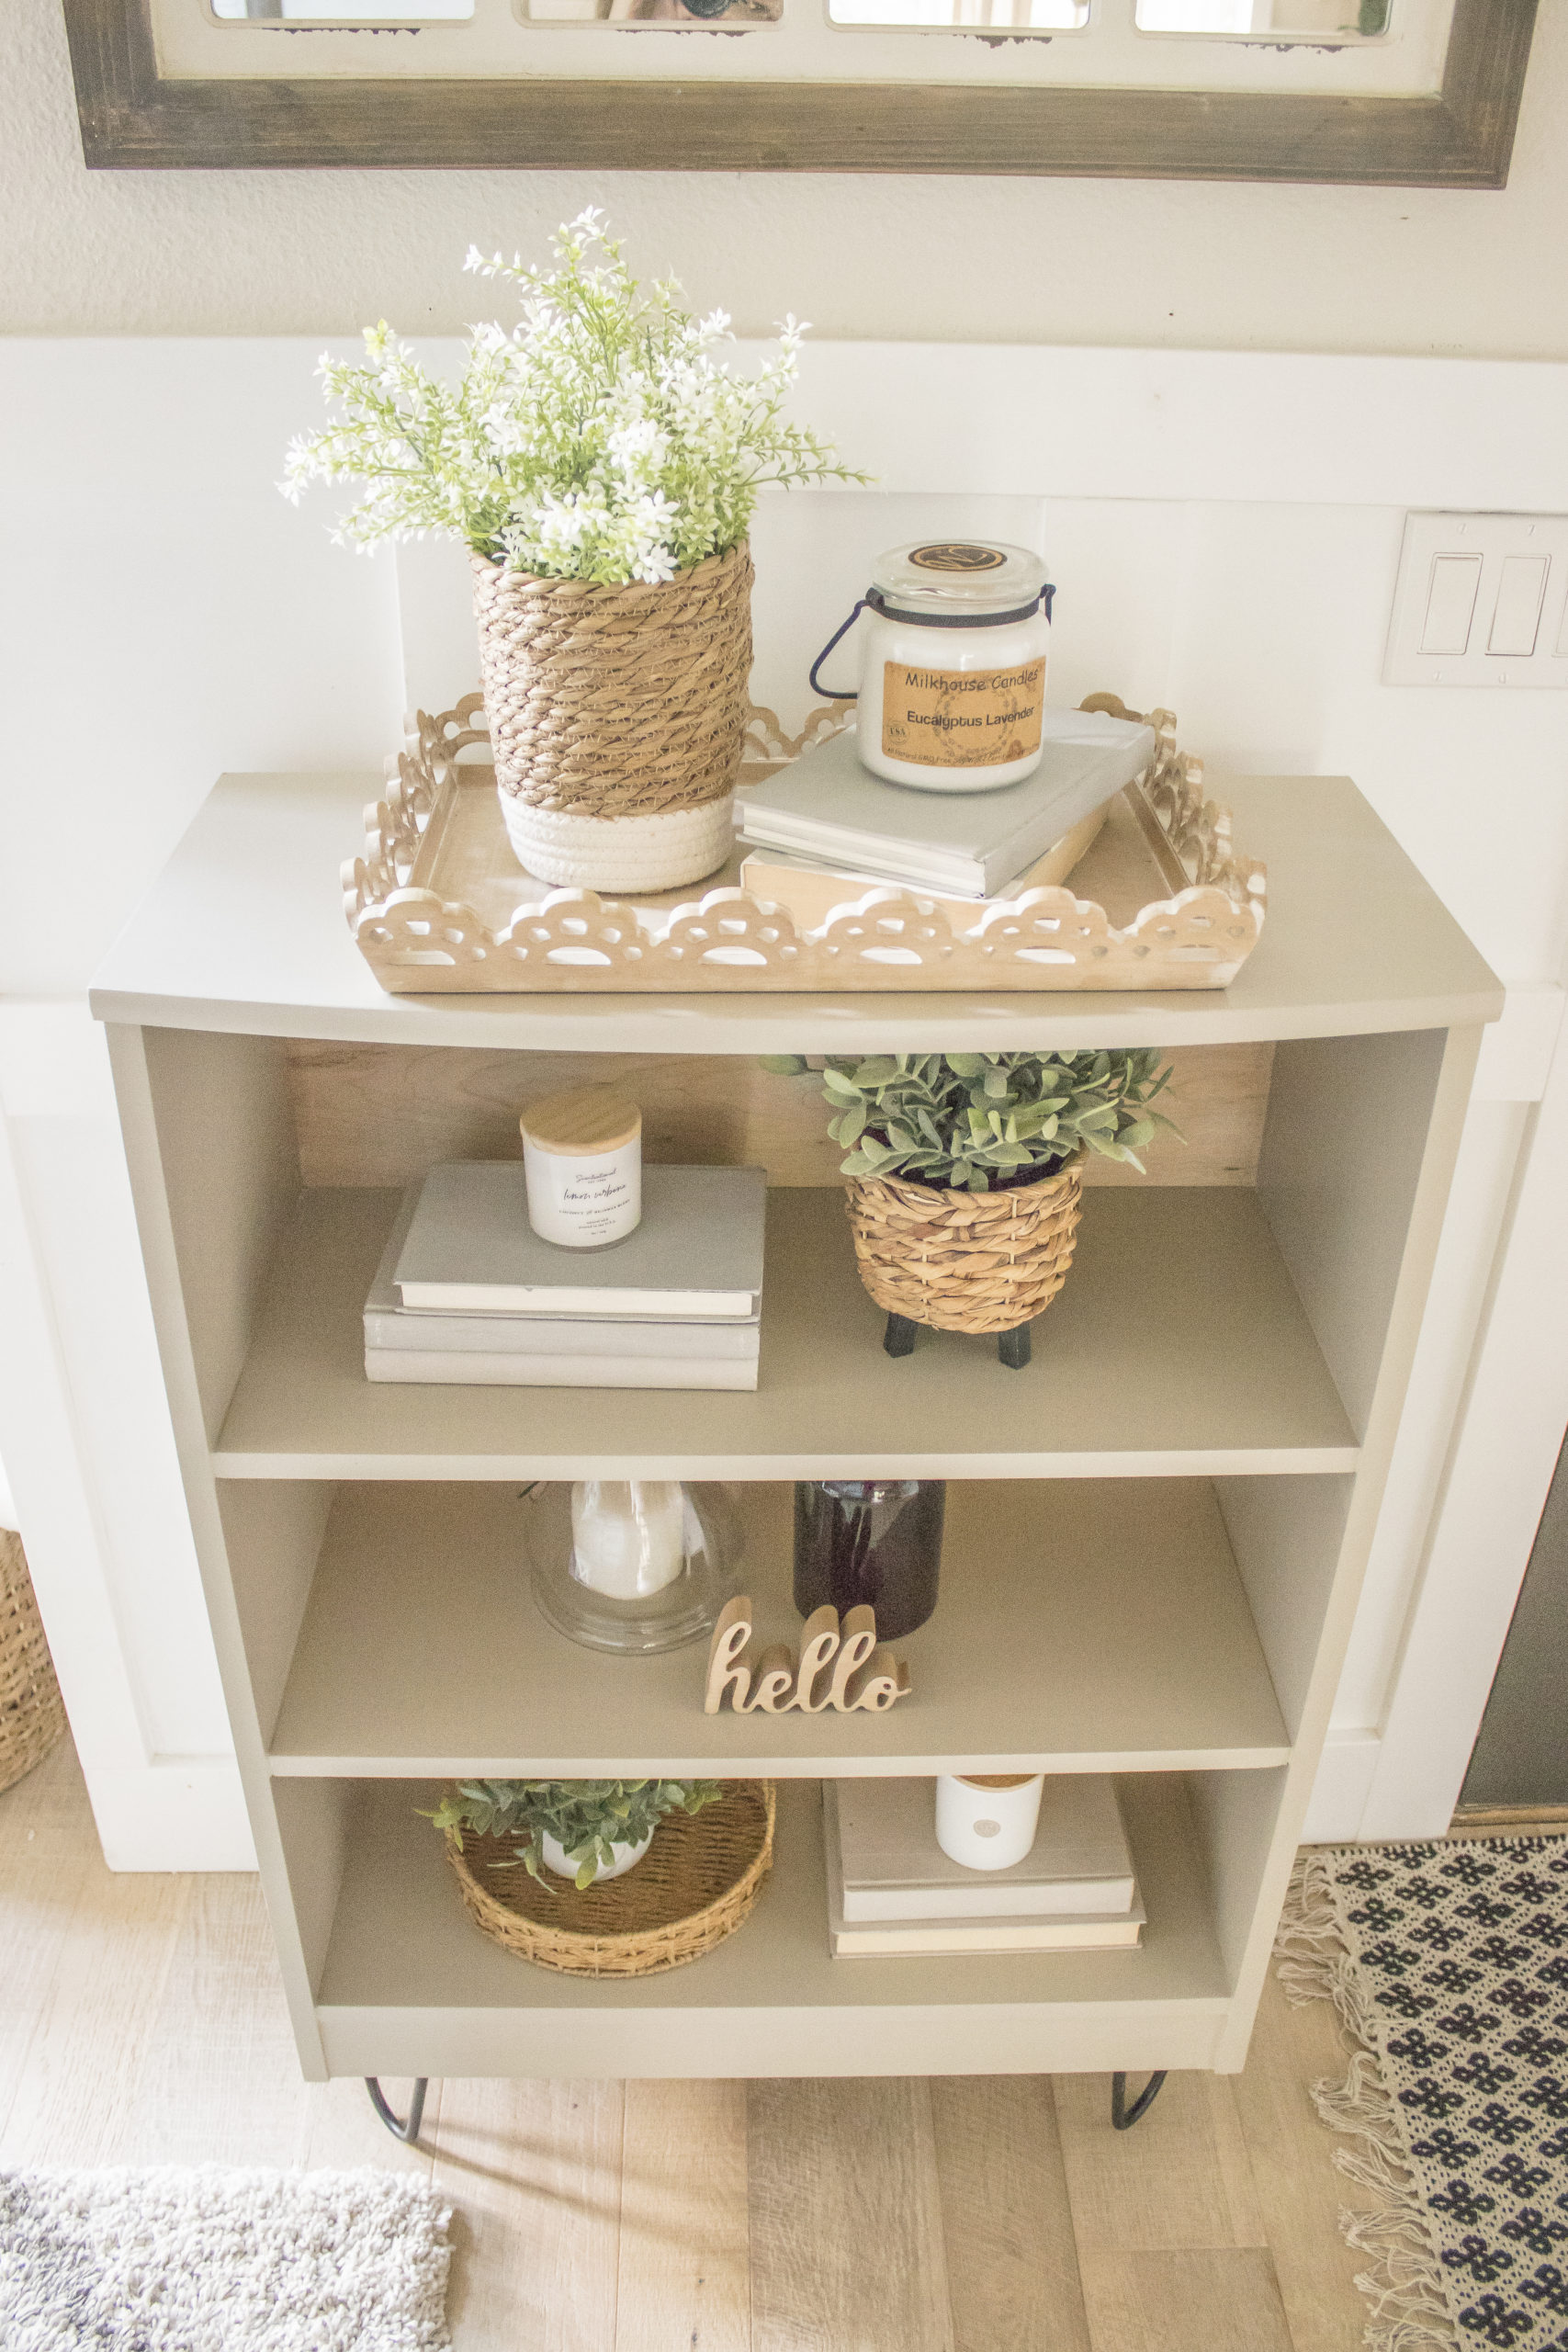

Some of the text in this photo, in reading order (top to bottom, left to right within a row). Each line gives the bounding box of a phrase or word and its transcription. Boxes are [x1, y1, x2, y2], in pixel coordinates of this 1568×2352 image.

[905, 668, 1039, 692] Milkhouse Candles
[907, 706, 1035, 731] Eucalyptus Lavender
[705, 1621, 912, 1715] hello
